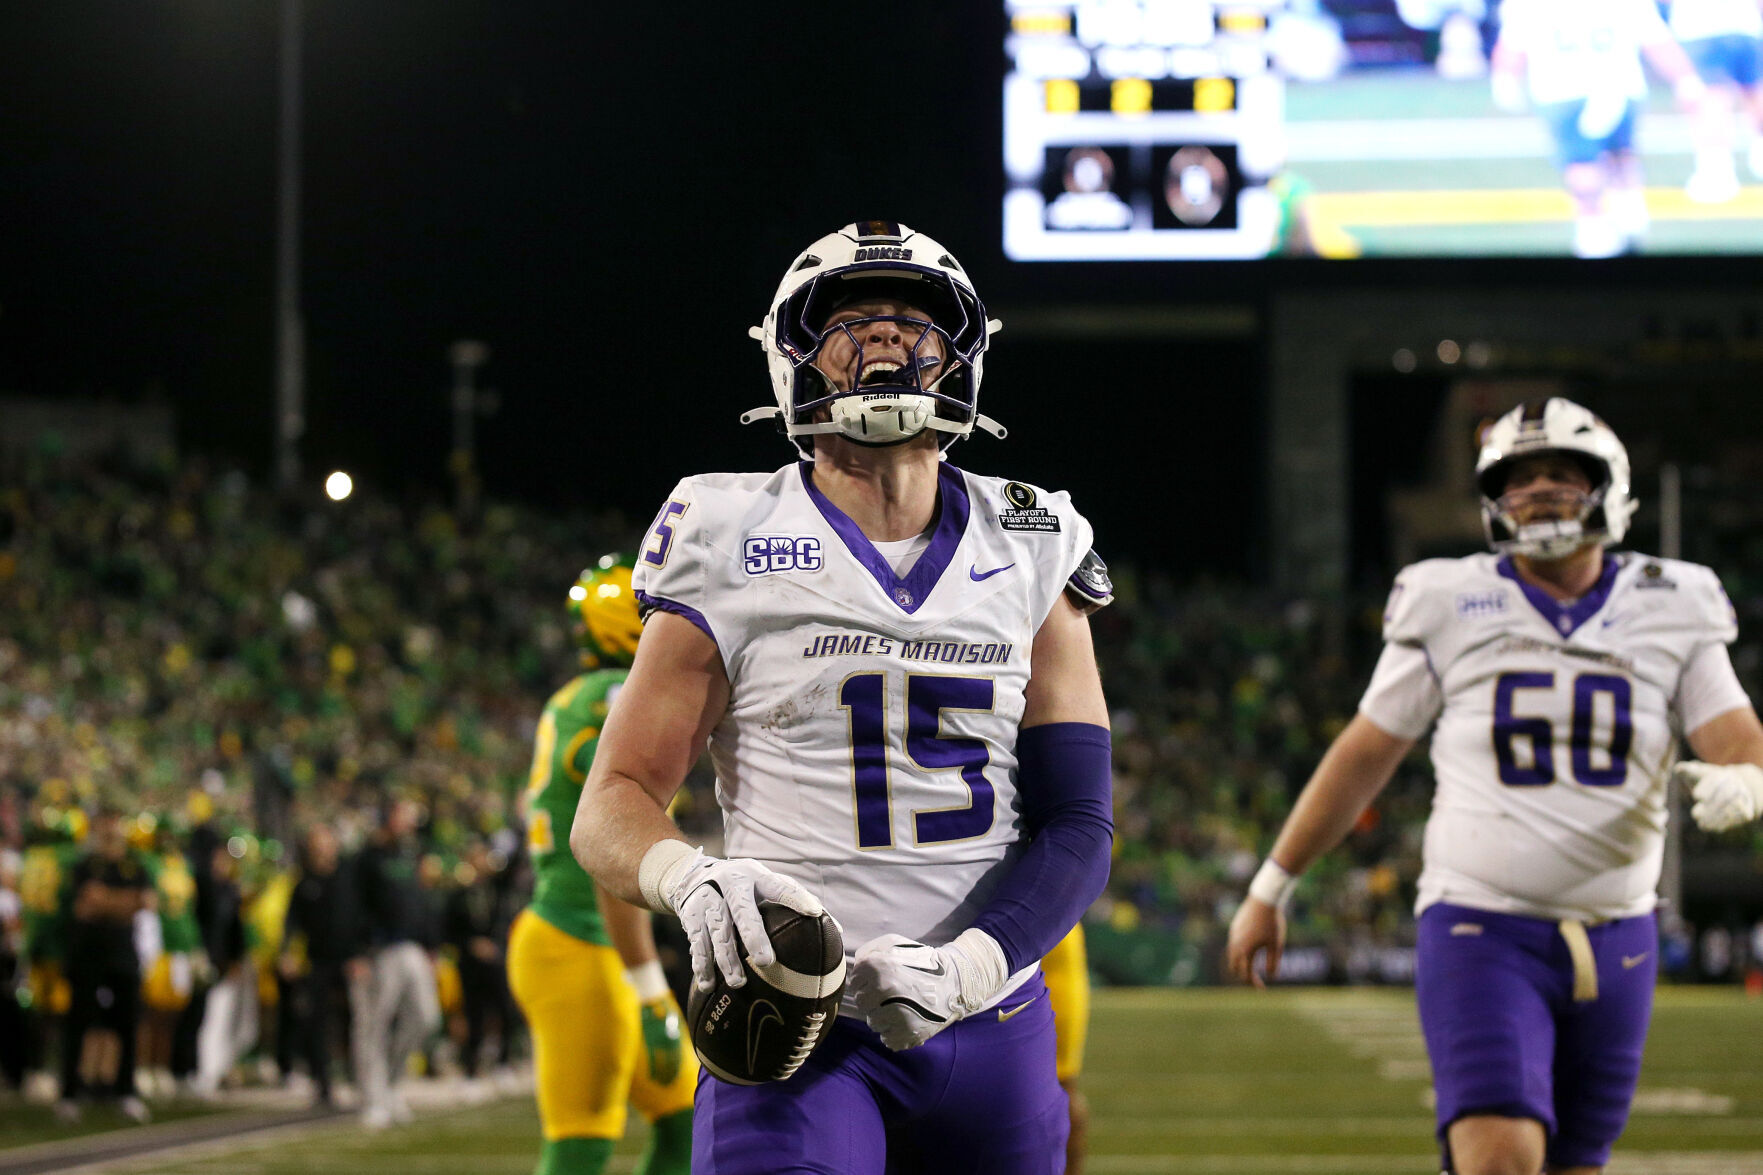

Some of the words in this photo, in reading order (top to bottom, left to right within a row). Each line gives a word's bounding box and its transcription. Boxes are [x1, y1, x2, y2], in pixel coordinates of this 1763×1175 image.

[854, 247, 913, 262] DUKES
[862, 393, 900, 402] Riddell
[1007, 509, 1046, 517] PLAYOFF
[1027, 516, 1057, 524] ROUND
[743, 537, 821, 575] SBC
[803, 634, 893, 658] JAMES
[900, 640, 1013, 665] MADISON
[1492, 670, 1634, 788] 60
[837, 670, 997, 852] 15
